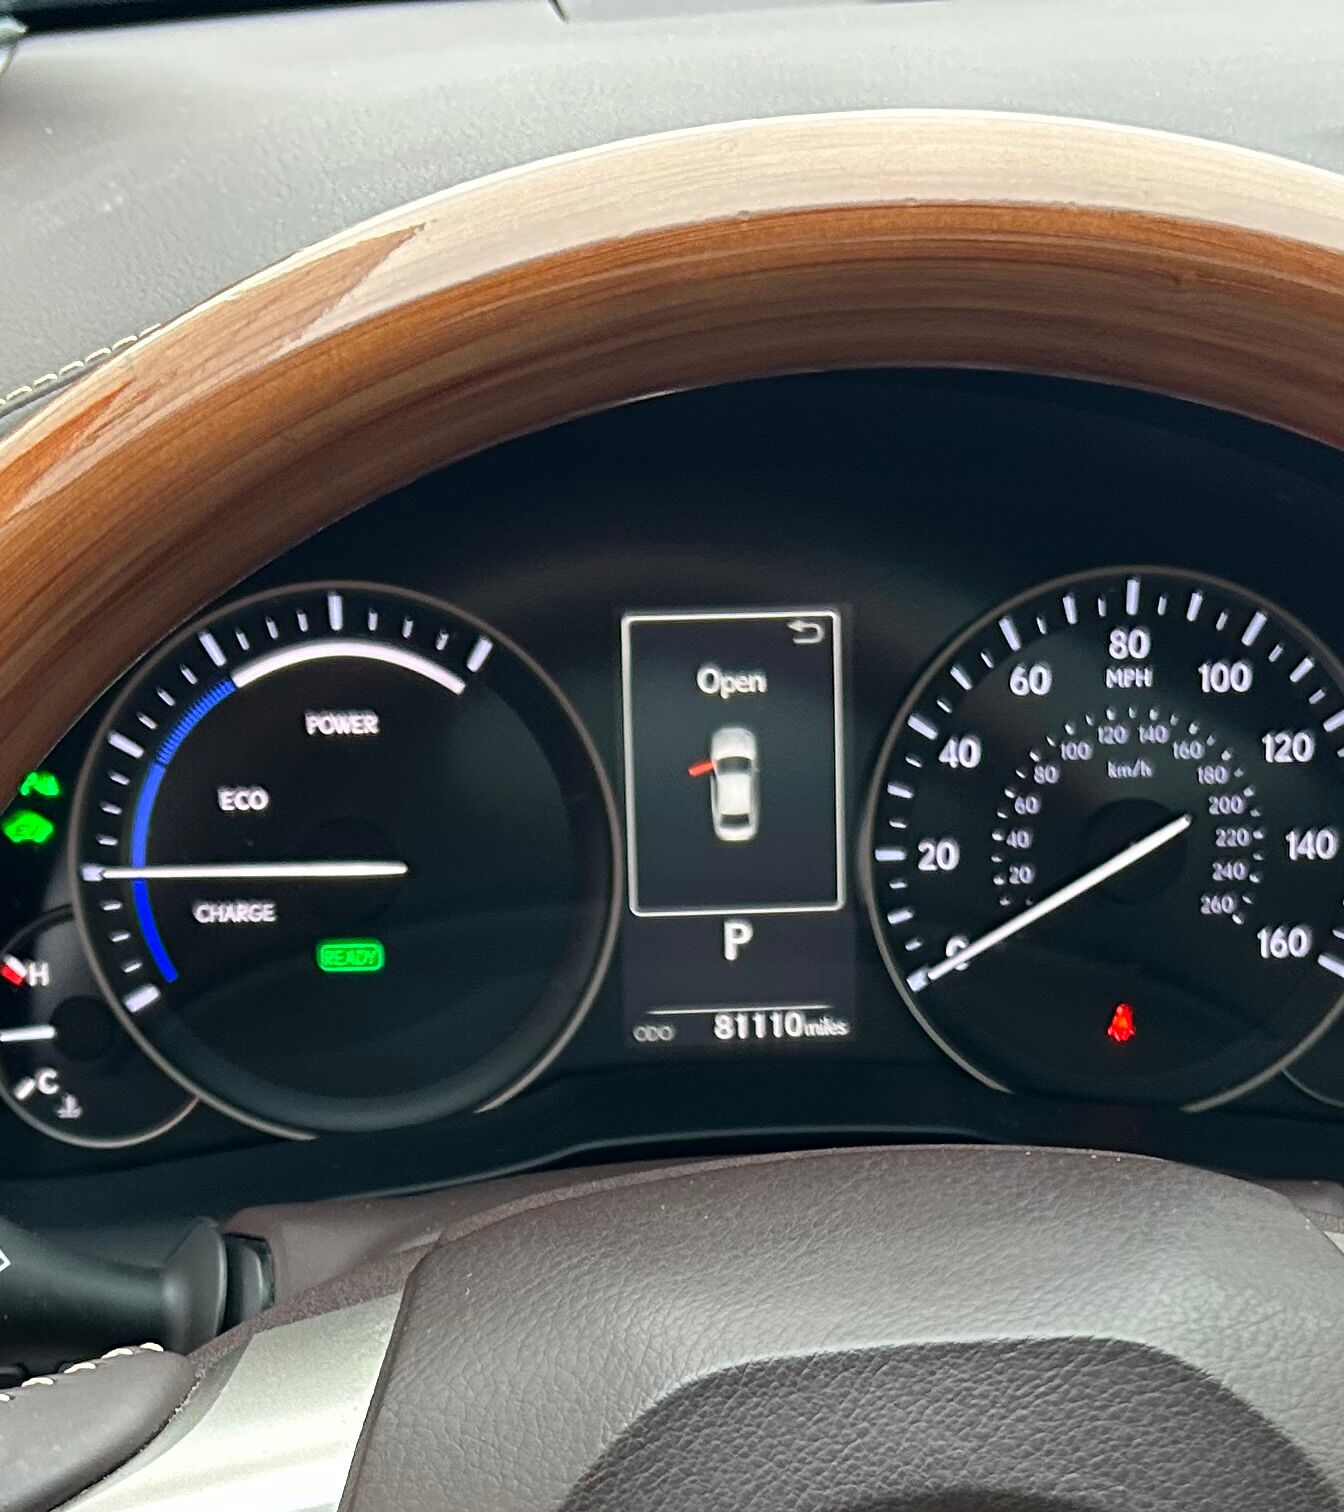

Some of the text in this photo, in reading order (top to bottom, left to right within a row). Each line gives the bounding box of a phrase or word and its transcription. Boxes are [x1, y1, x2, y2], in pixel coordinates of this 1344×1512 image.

[1108, 629, 1151, 661] 80
[696, 666, 768, 699] Open
[1009, 664, 1053, 697] 60
[1105, 667, 1153, 689] MPH
[1198, 661, 1253, 694] 100
[306, 711, 380, 737] POWER
[1097, 724, 1127, 745] 120
[1138, 724, 1168, 745] 140
[938, 737, 982, 770] 40
[1060, 741, 1092, 761] 100
[1172, 740, 1204, 760] 160
[1262, 731, 1315, 763] 120
[1033, 765, 1059, 785] 80
[1107, 760, 1154, 779] km/h
[1197, 765, 1228, 785] 180
[218, 786, 270, 813] ECO
[1014, 796, 1040, 816] 60
[1208, 796, 1244, 815] 200
[1006, 829, 1032, 849] 40
[1215, 828, 1250, 848] 220
[1286, 829, 1338, 861] 140
[917, 840, 960, 871] 20
[1009, 866, 1034, 885] 20
[1211, 861, 1247, 881] 240
[192, 902, 278, 924] CHARGE
[1200, 895, 1236, 915] 260
[723, 919, 753, 961] P
[1257, 927, 1312, 959] 160
[323, 948, 380, 967] READY
[27, 963, 49, 987] H
[37, 1071, 59, 1095] C
